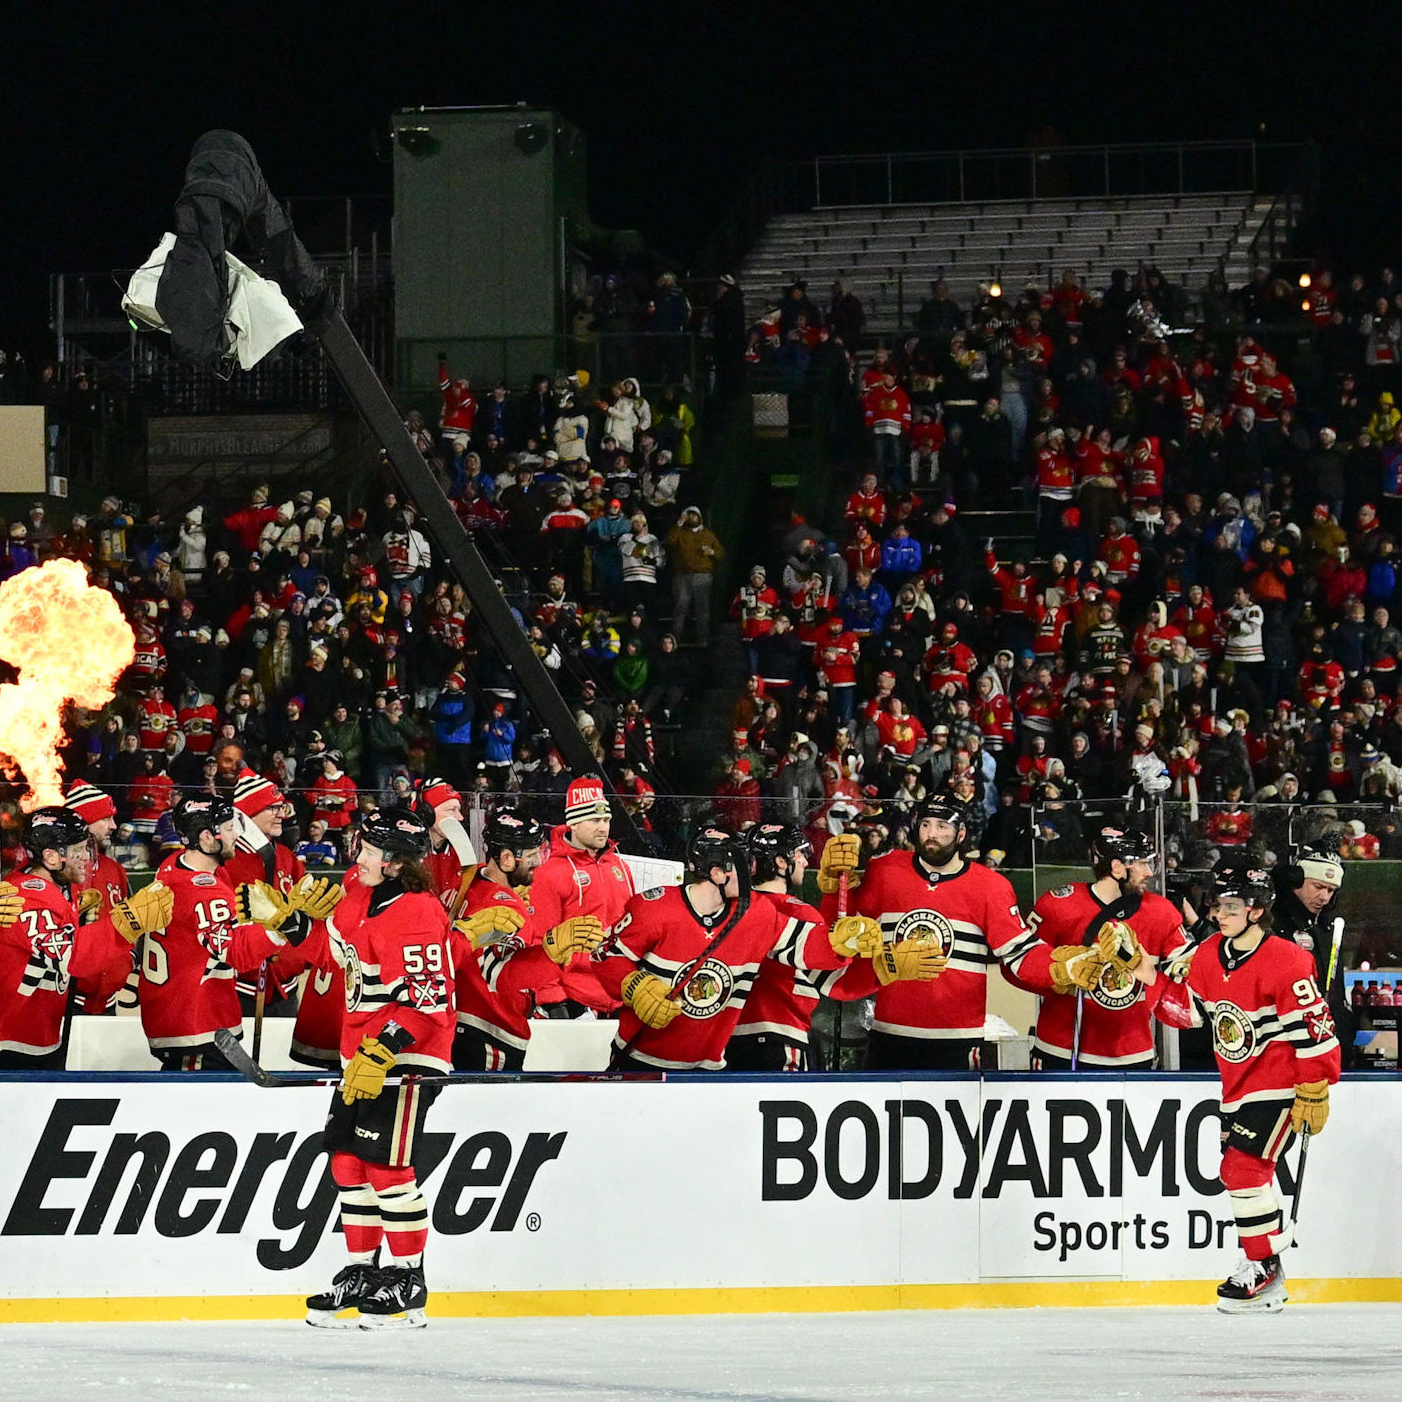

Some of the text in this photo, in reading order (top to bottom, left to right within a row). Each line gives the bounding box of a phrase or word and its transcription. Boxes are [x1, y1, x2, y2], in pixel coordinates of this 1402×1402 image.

[19, 910, 59, 938] 71
[194, 898, 230, 930] 16
[897, 911, 952, 944] BLACKHAWKS
[402, 944, 442, 974] 59
[1095, 989, 1136, 1008] CHICAGO
[1033, 1211, 1170, 1262] Sports
